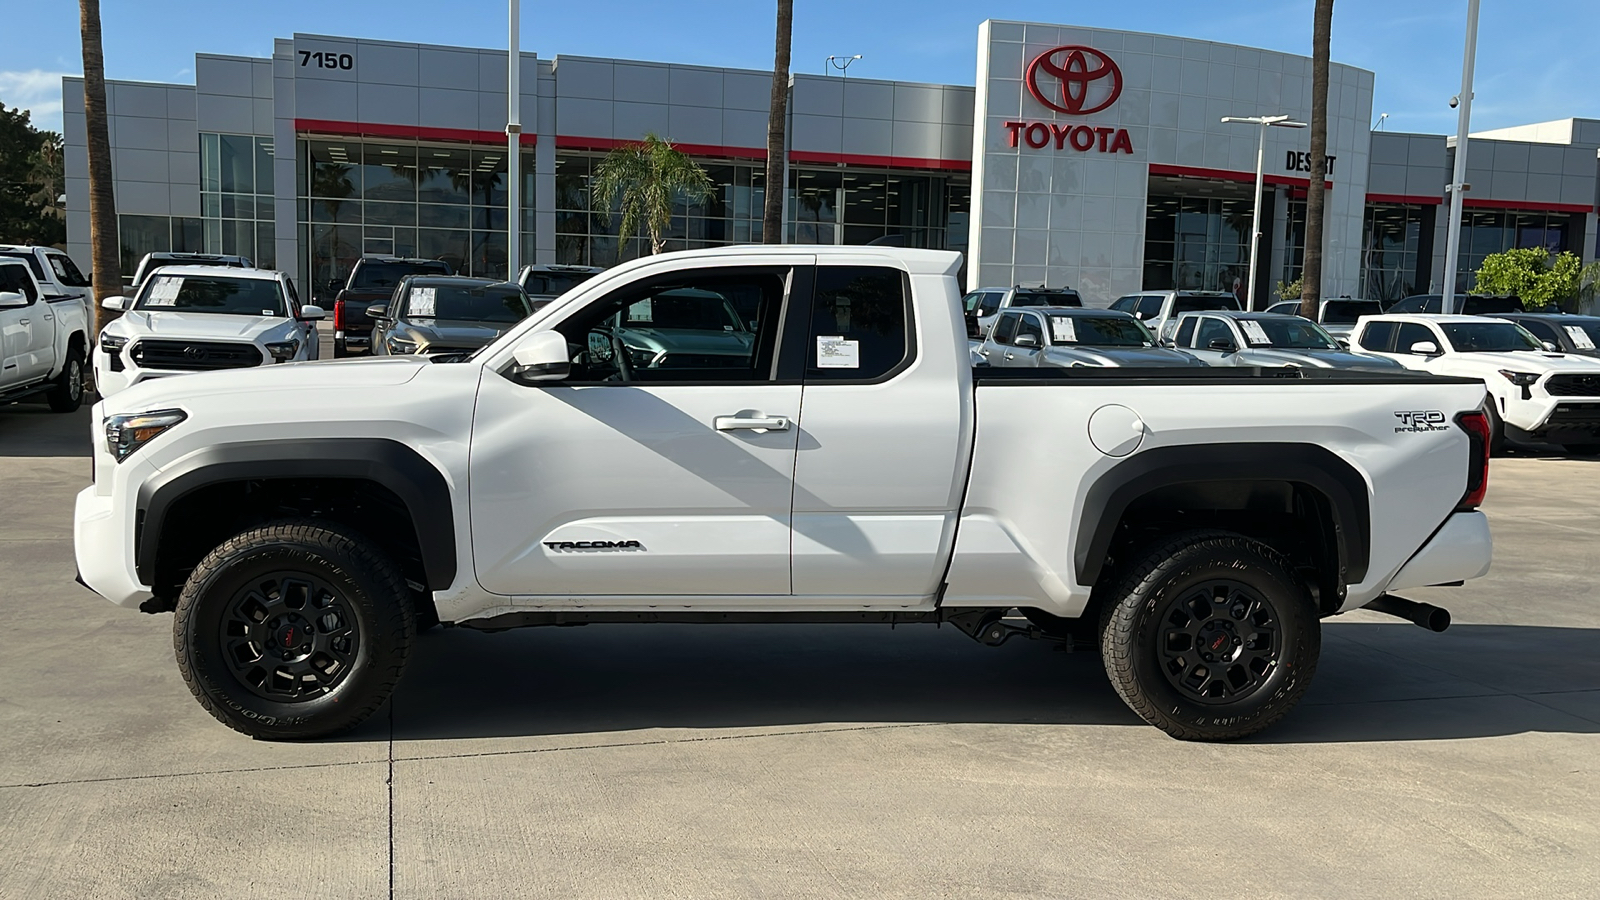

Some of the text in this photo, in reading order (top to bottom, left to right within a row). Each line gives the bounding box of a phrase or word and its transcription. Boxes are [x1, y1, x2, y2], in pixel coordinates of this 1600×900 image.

[298, 50, 353, 70] 7150
[1004, 121, 1134, 154] TOYOTA
[1286, 150, 1337, 175] DEST
[1394, 410, 1446, 427] TRD
[543, 540, 641, 550] TACOMA
